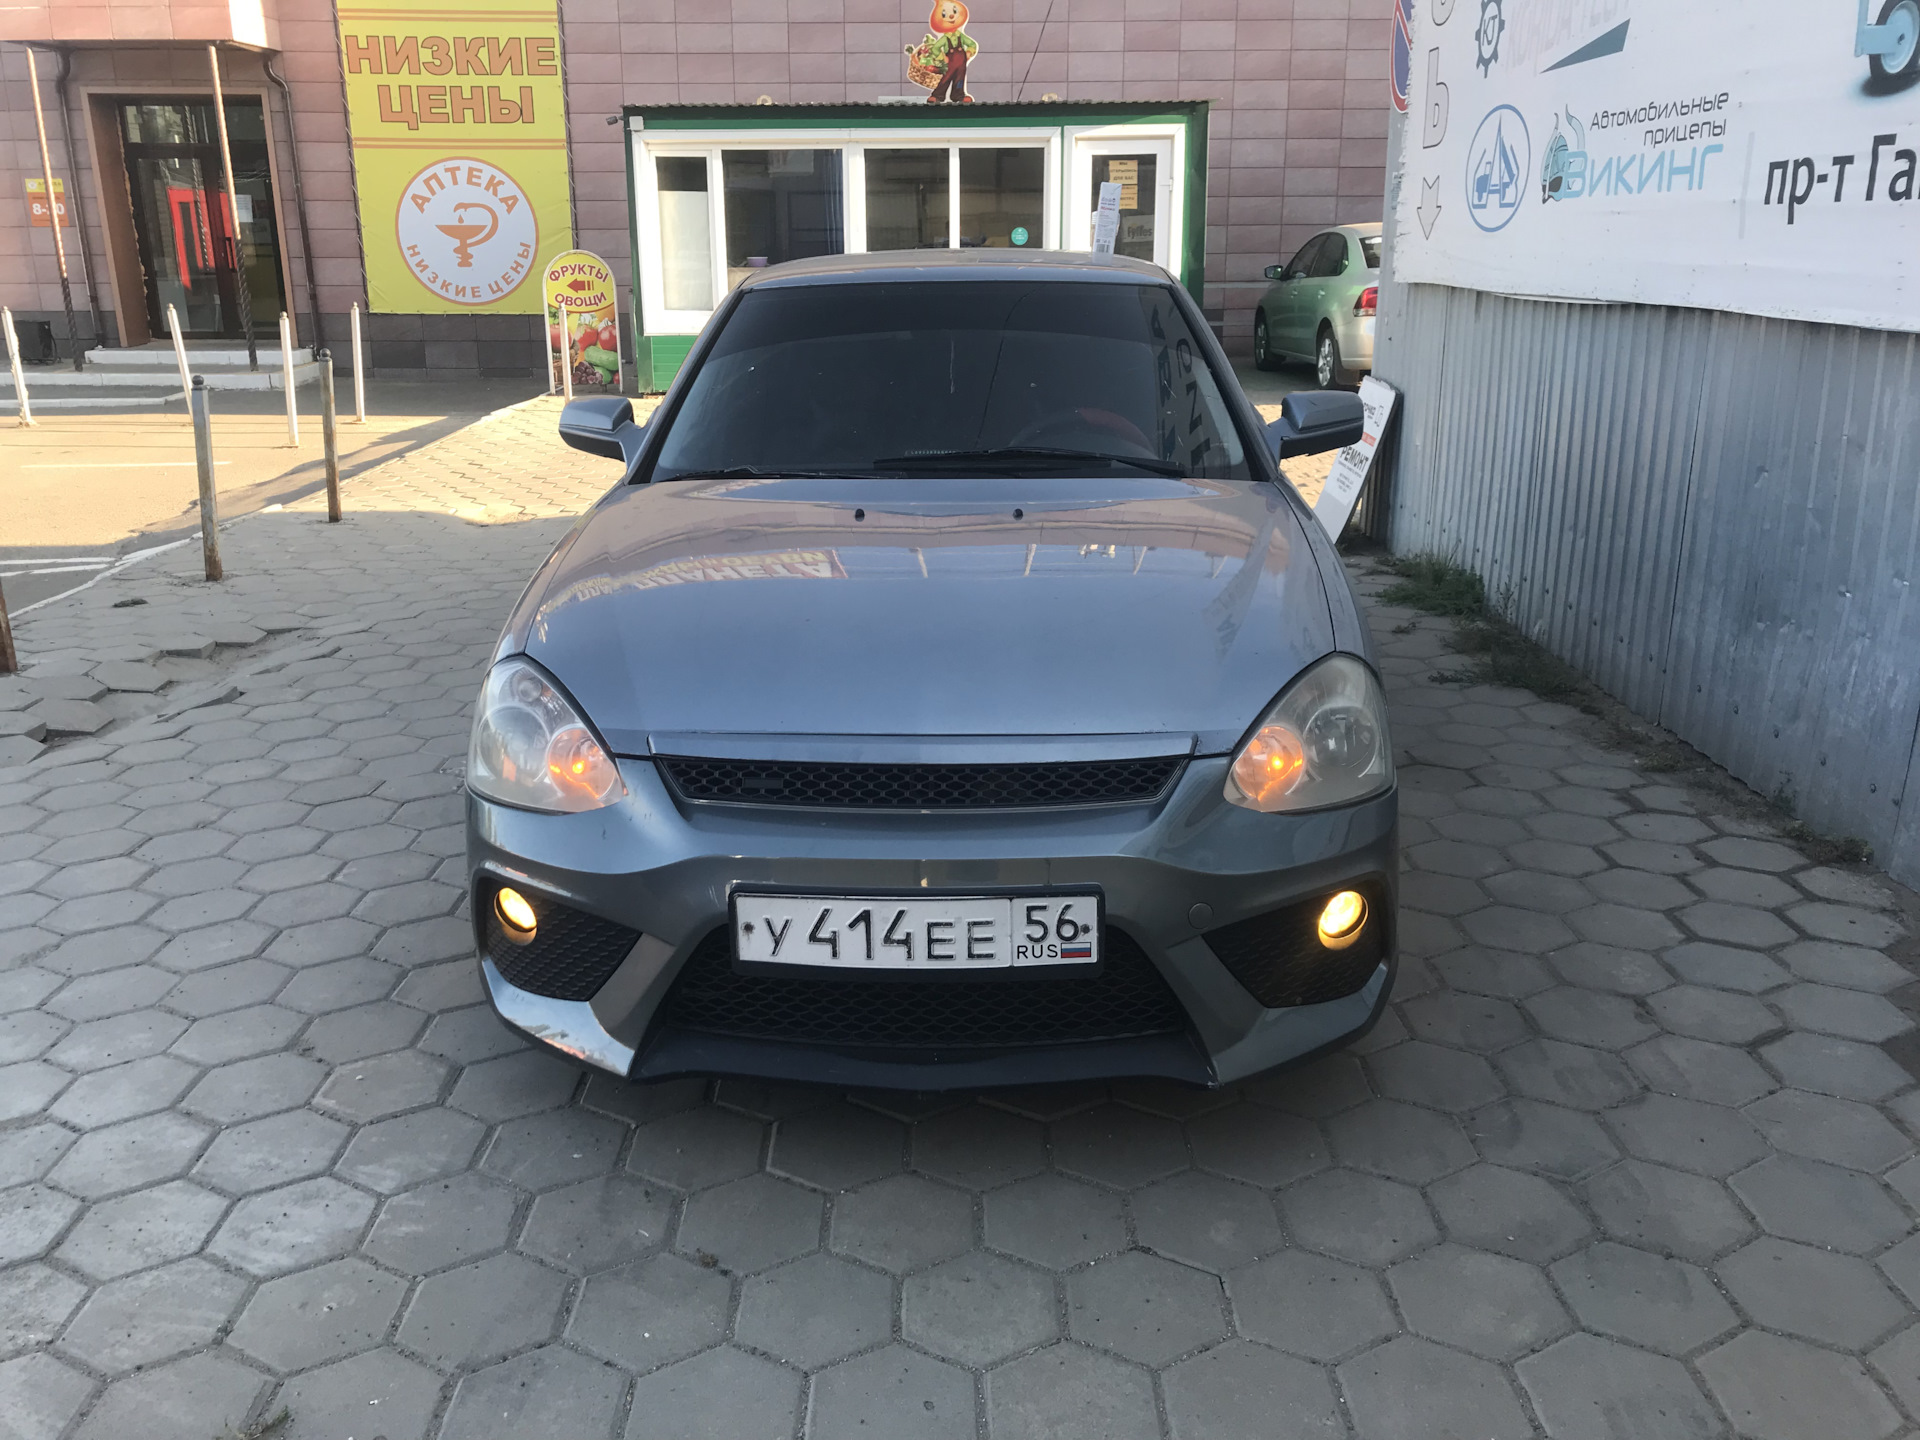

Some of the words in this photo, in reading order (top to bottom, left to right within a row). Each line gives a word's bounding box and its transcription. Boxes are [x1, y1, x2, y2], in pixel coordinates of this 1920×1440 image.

[345, 35, 558, 76] НИЗКИЕ
[377, 85, 535, 130] ЦЕНЫ
[1590, 92, 1729, 131] Автомобильные
[1643, 119, 1727, 148] прицепы
[410, 166, 519, 214] АПТЕКА
[1764, 155, 1855, 225] пр-т
[1865, 133, 1920, 202] Га
[32, 203, 65, 215] 8-0
[407, 244, 481, 298] НИЗКИЕ
[488, 242, 531, 295] ЦЕНЫ
[549, 264, 609, 283] ФРУКТЫ
[554, 292, 607, 307] ОВОЩИ
[1340, 446, 1369, 473] РЕМОНТ
[1023, 903, 1082, 944] 56
[1016, 944, 1059, 960] RUS
